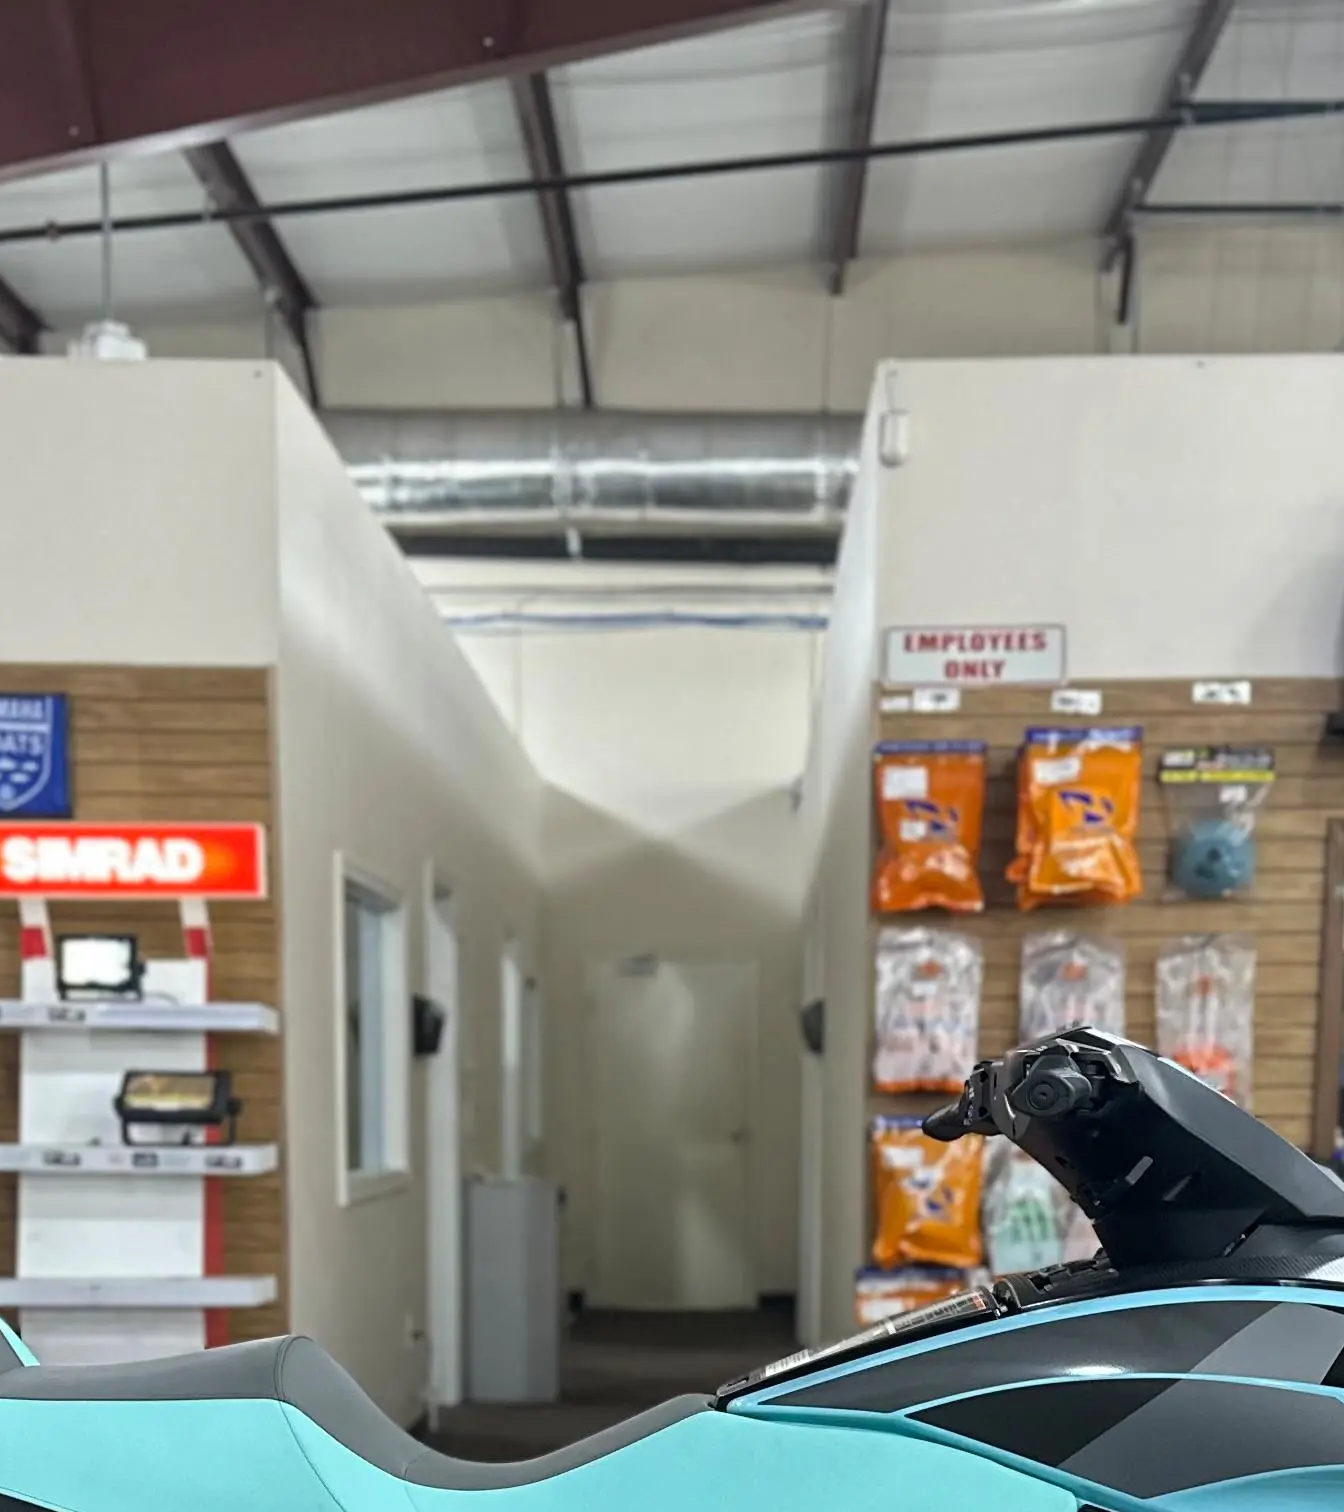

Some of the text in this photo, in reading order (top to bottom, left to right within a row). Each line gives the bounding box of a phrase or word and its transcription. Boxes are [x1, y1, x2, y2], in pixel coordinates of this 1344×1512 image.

[903, 632, 1047, 653] EMPLOYEES
[944, 660, 1005, 680] ONLY
[1, 836, 204, 884] SIMRAD
